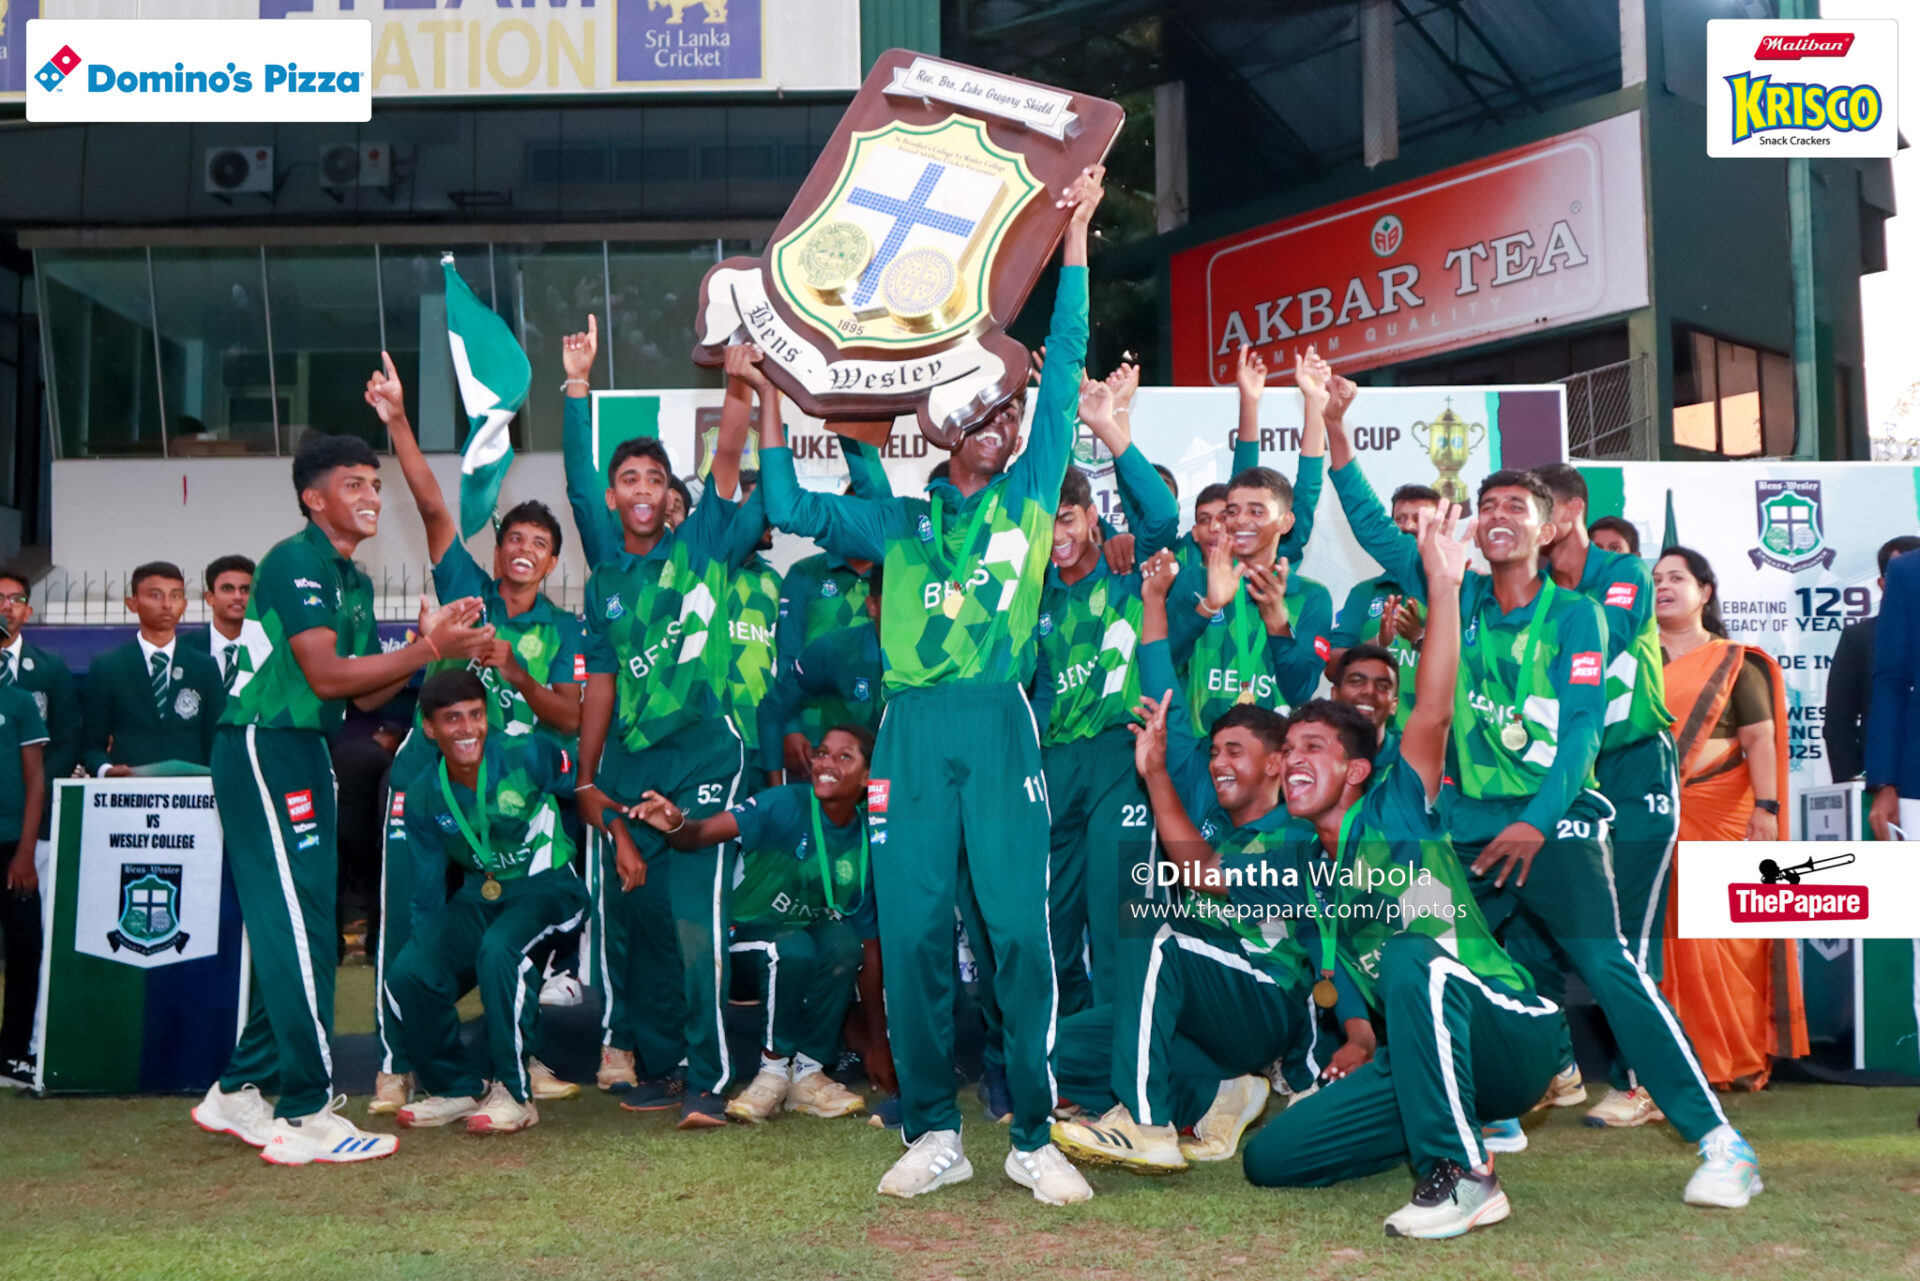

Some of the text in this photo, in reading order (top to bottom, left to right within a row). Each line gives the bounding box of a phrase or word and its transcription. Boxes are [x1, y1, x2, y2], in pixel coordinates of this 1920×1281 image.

[645, 29, 731, 47] Sri Lanka
[655, 48, 722, 68] Cricket
[915, 69, 1055, 115] Rev. Bro. Luke Gregory Shield
[1217, 220, 1589, 357] AKBAR TEA
[836, 318, 865, 335] 1895
[1365, 299, 1501, 341] QUALITY
[744, 301, 801, 363] Bens
[829, 359, 943, 390] Wesley
[792, 435, 838, 459] UKE
[1353, 426, 1401, 451] CUP
[1722, 600, 1788, 614] EBRATING
[1794, 586, 1872, 617] 129
[1723, 618, 1789, 632] EGACY OF
[1777, 655, 1807, 670] DE
[697, 783, 723, 805] 52
[1023, 775, 1045, 802] 11
[94, 792, 216, 810] ST. BENEDICT'S COLLEGE
[1643, 793, 1670, 815] 13
[146, 814, 160, 828] VS
[1121, 803, 1147, 827] 22
[1556, 819, 1591, 840] 20
[109, 833, 195, 850] WESLEY COLLEGE
